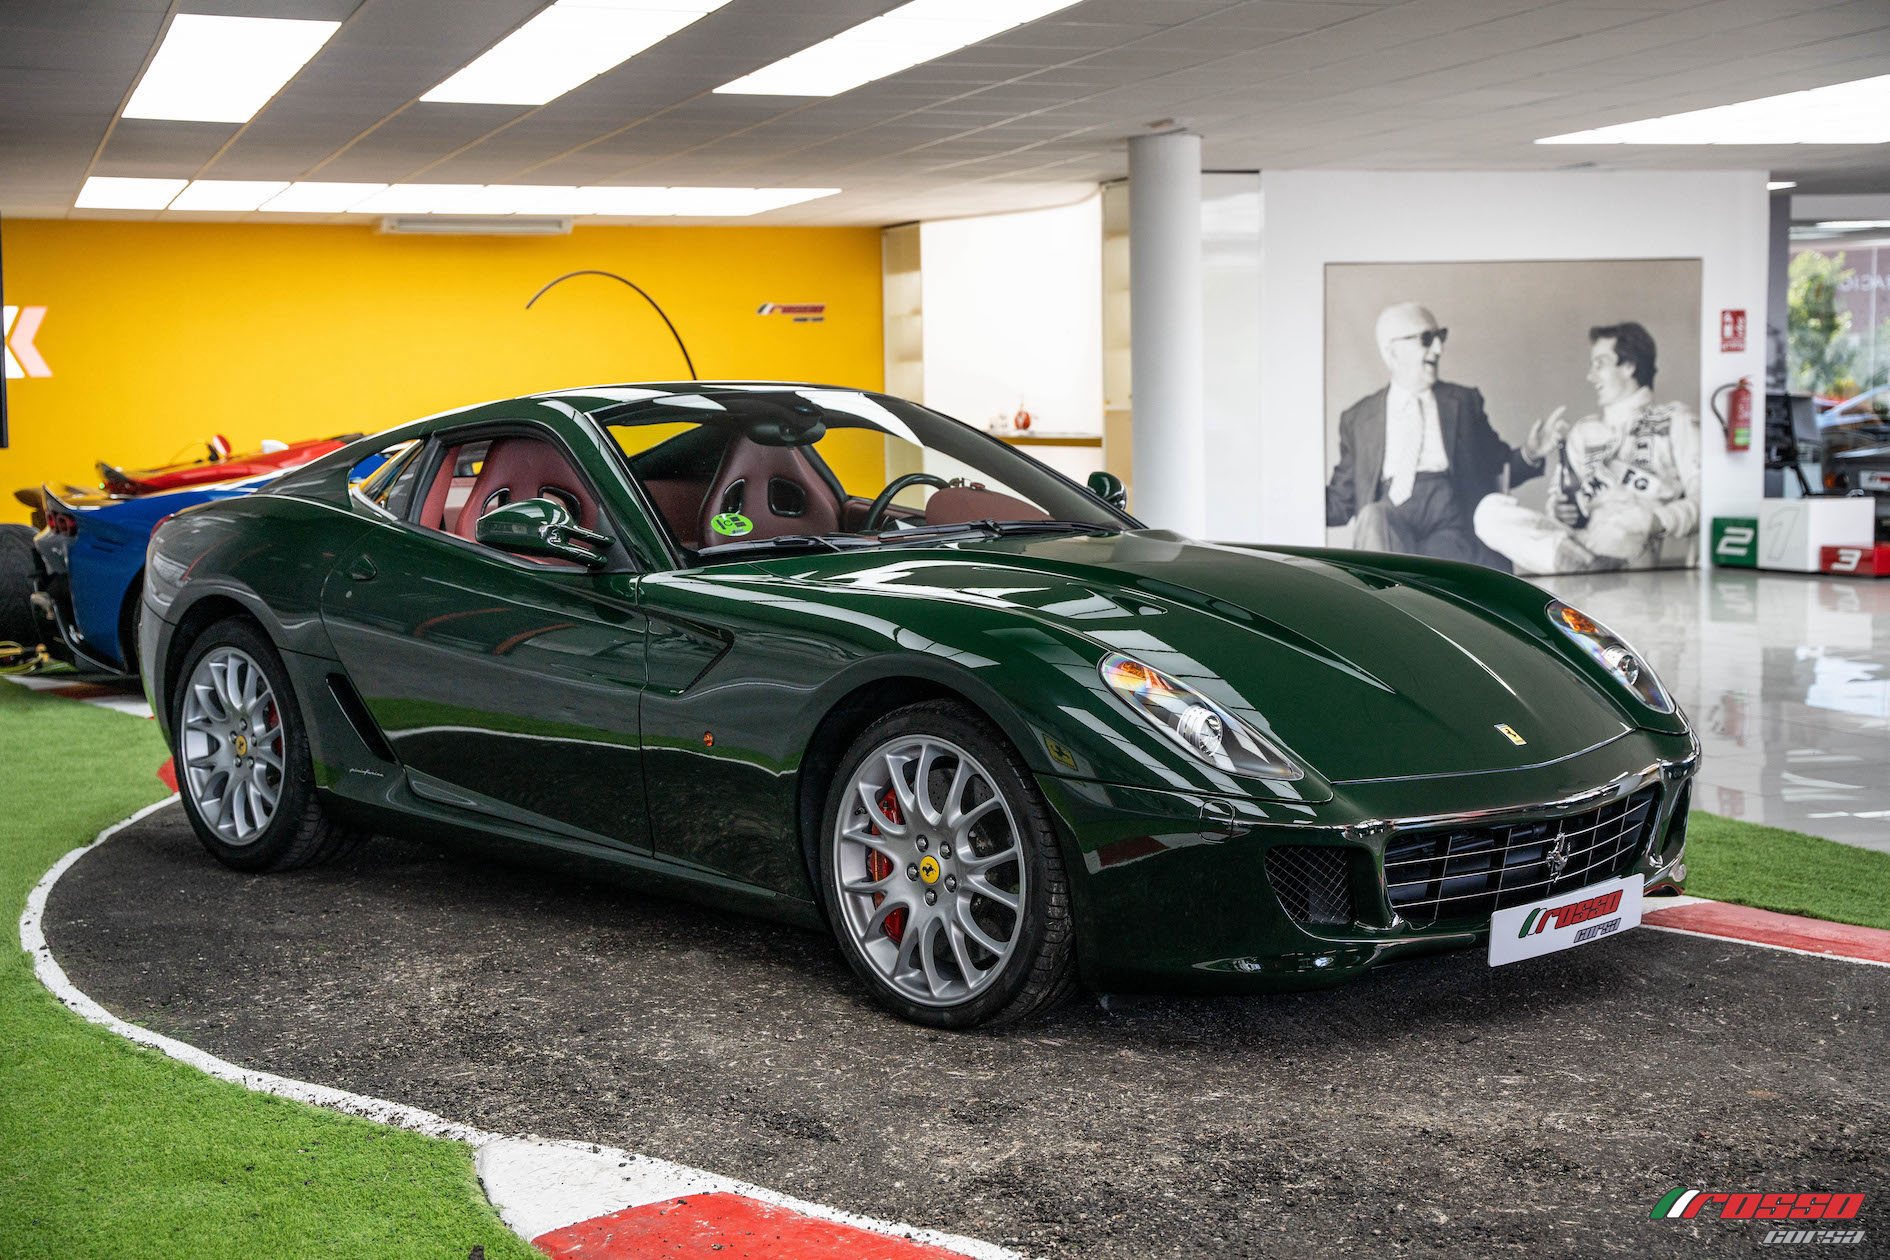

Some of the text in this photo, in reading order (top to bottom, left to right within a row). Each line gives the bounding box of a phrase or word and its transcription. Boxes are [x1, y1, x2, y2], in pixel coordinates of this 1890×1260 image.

[1715, 526, 1755, 556] 2
[1766, 506, 1800, 561] 1
[1831, 548, 1862, 571] 3
